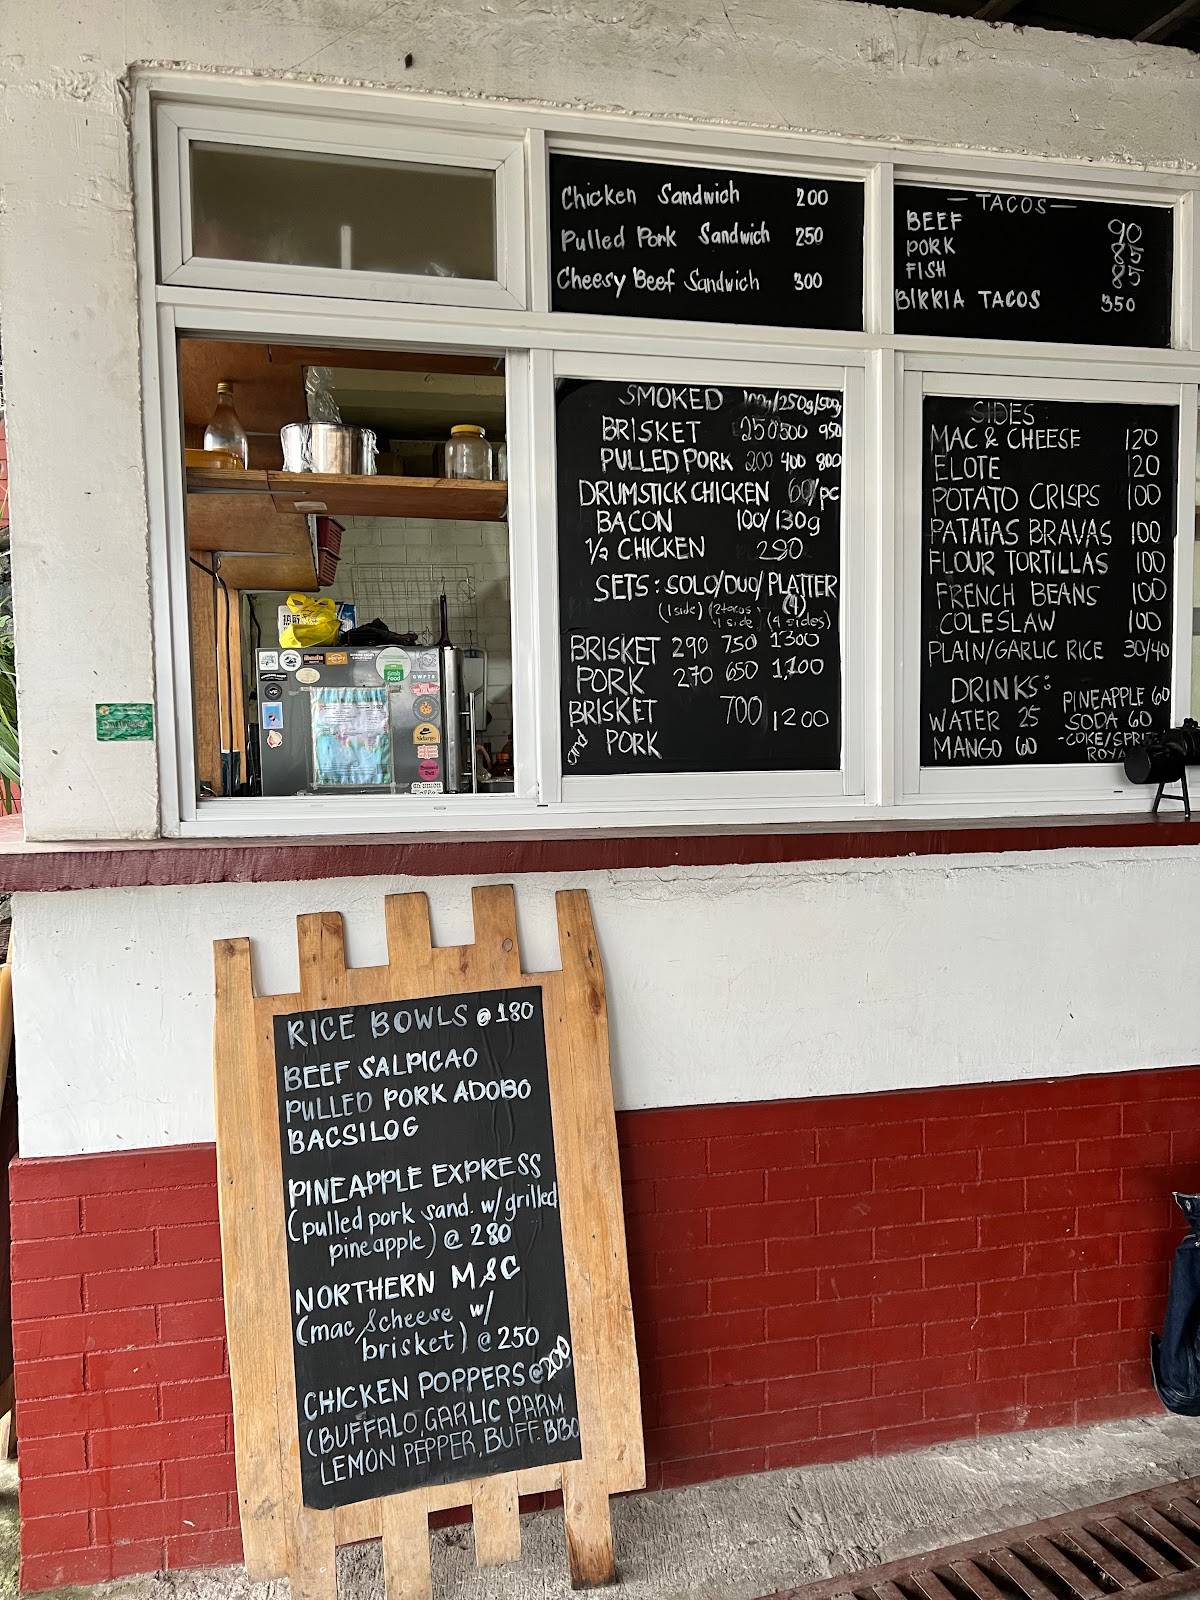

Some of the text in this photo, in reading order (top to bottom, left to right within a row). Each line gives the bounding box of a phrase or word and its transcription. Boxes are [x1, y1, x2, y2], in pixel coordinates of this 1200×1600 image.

[562, 180, 828, 209] Chicken Sandwich 200
[562, 222, 823, 251] Pulled Pork Sandwich 250
[907, 210, 1142, 244] BEEF 90
[907, 237, 1144, 264] PORK 85
[557, 267, 822, 298] Cheesy Beef Sandwich 300
[906, 261, 1144, 288] FISH 85
[978, 290, 1040, 309] TACOS
[1101, 294, 1135, 312] 350
[619, 385, 723, 410] SMOKED
[971, 401, 1035, 425] SIDES
[603, 416, 700, 443] BRISKET
[819, 421, 842, 440] 950
[931, 424, 1158, 452] MAC & CHEESE 120
[601, 448, 841, 473] PULLED PORK 200 400 800
[935, 454, 1160, 482] ELOTE 120
[579, 479, 687, 506] DRUMSTICK
[691, 481, 769, 505] CHICKEN
[933, 483, 1161, 516] POTATO CRISPS 100
[597, 508, 672, 535] BACON
[930, 518, 1160, 547] PATATAS BRAVAS 100
[618, 536, 704, 560] CHICKEN
[930, 548, 1165, 576] FLOUR TORTILLAS 100
[937, 578, 1167, 610] FRENCH BEANS 100
[940, 610, 1161, 635] COLESLAW 100
[571, 635, 661, 665] BRISKET
[672, 637, 708, 659] 290
[721, 634, 757, 653] 750
[929, 639, 1169, 667] PLAIN/GARLIC RICE 30/40
[577, 665, 644, 696] PORK
[673, 666, 713, 687] 270
[726, 661, 758, 681] 650
[569, 696, 829, 731] BRISKET 700 1200
[1064, 686, 1170, 714] PINEAPPLE 60
[929, 705, 1041, 732] WATER 25
[1065, 710, 1152, 730] SODA 60
[567, 729, 663, 765] and PORK
[933, 736, 1037, 760] MANGO 60
[1087, 747, 1126, 761] ROYA
[287, 1013, 356, 1050] RICE
[371, 1004, 468, 1039] BOWLS
[283, 1048, 478, 1092] BEEF SALPICAO
[286, 1079, 532, 1123] PULLED PORK ADOBO
[288, 1116, 419, 1155] BACSILOG
[288, 1152, 541, 1209] PINEAPPLE EXPRESS
[288, 1206, 362, 1245] (pulled
[369, 1202, 415, 1234] pork
[421, 1192, 474, 1220] sand.
[330, 1223, 436, 1267] pineapple)
[295, 1270, 435, 1316] NORTHERN
[470, 1290, 493, 1326] w/
[362, 1321, 468, 1362] brisket)
[303, 1376, 409, 1421] CHICKEN
[419, 1362, 524, 1399] POPPERS
[320, 1442, 396, 1486] LEMON
